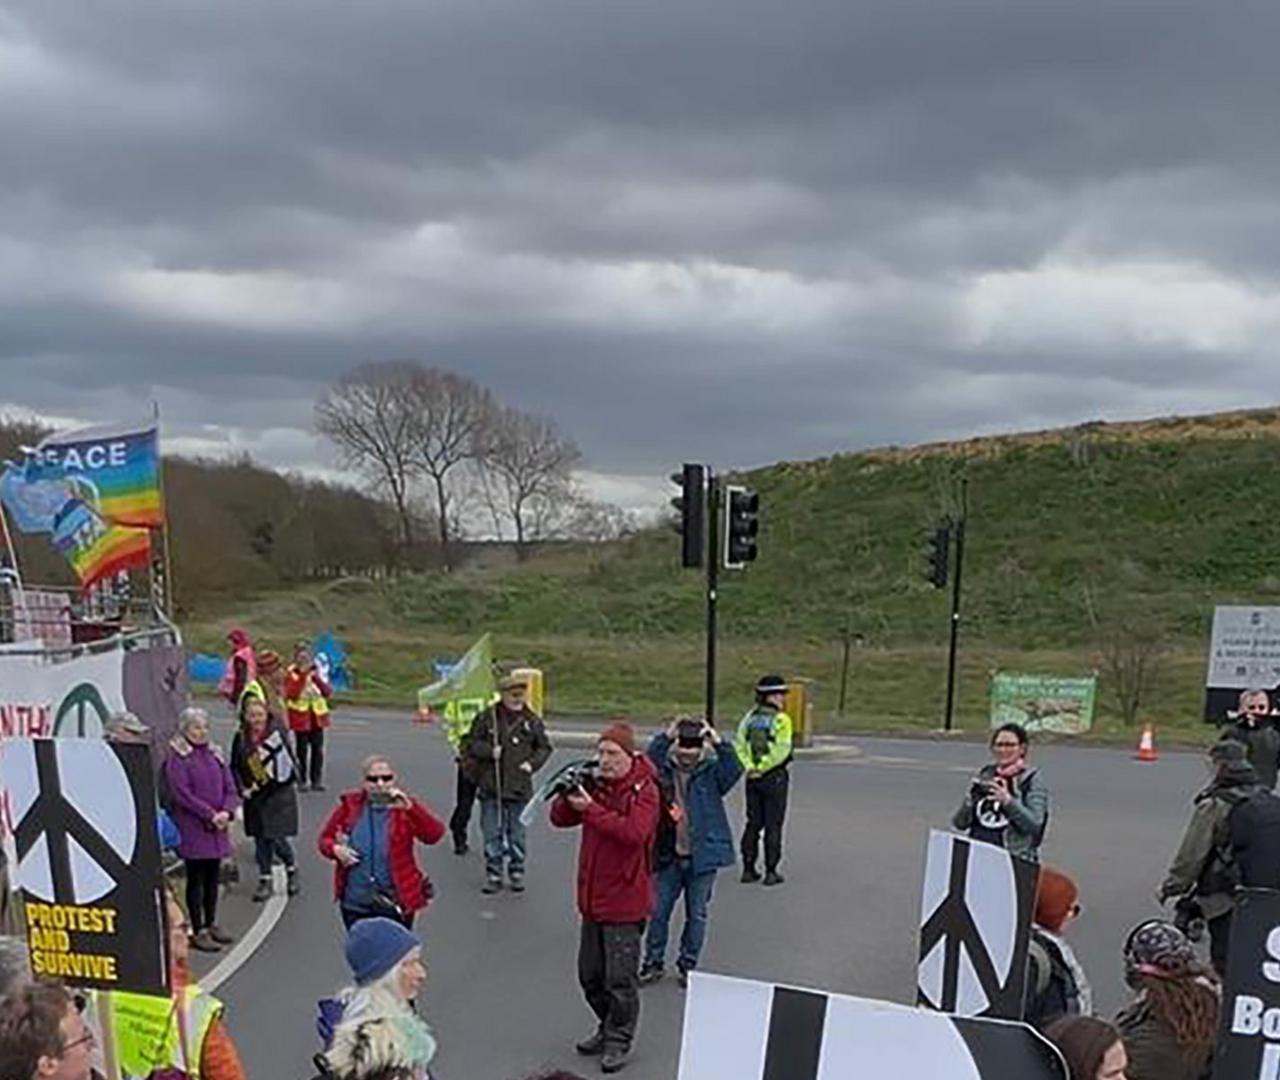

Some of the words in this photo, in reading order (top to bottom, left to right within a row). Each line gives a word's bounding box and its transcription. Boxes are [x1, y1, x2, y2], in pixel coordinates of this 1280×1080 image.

[26, 903, 117, 932] PROTEST
[30, 927, 70, 951] AND
[32, 950, 118, 980] SURVIVE
